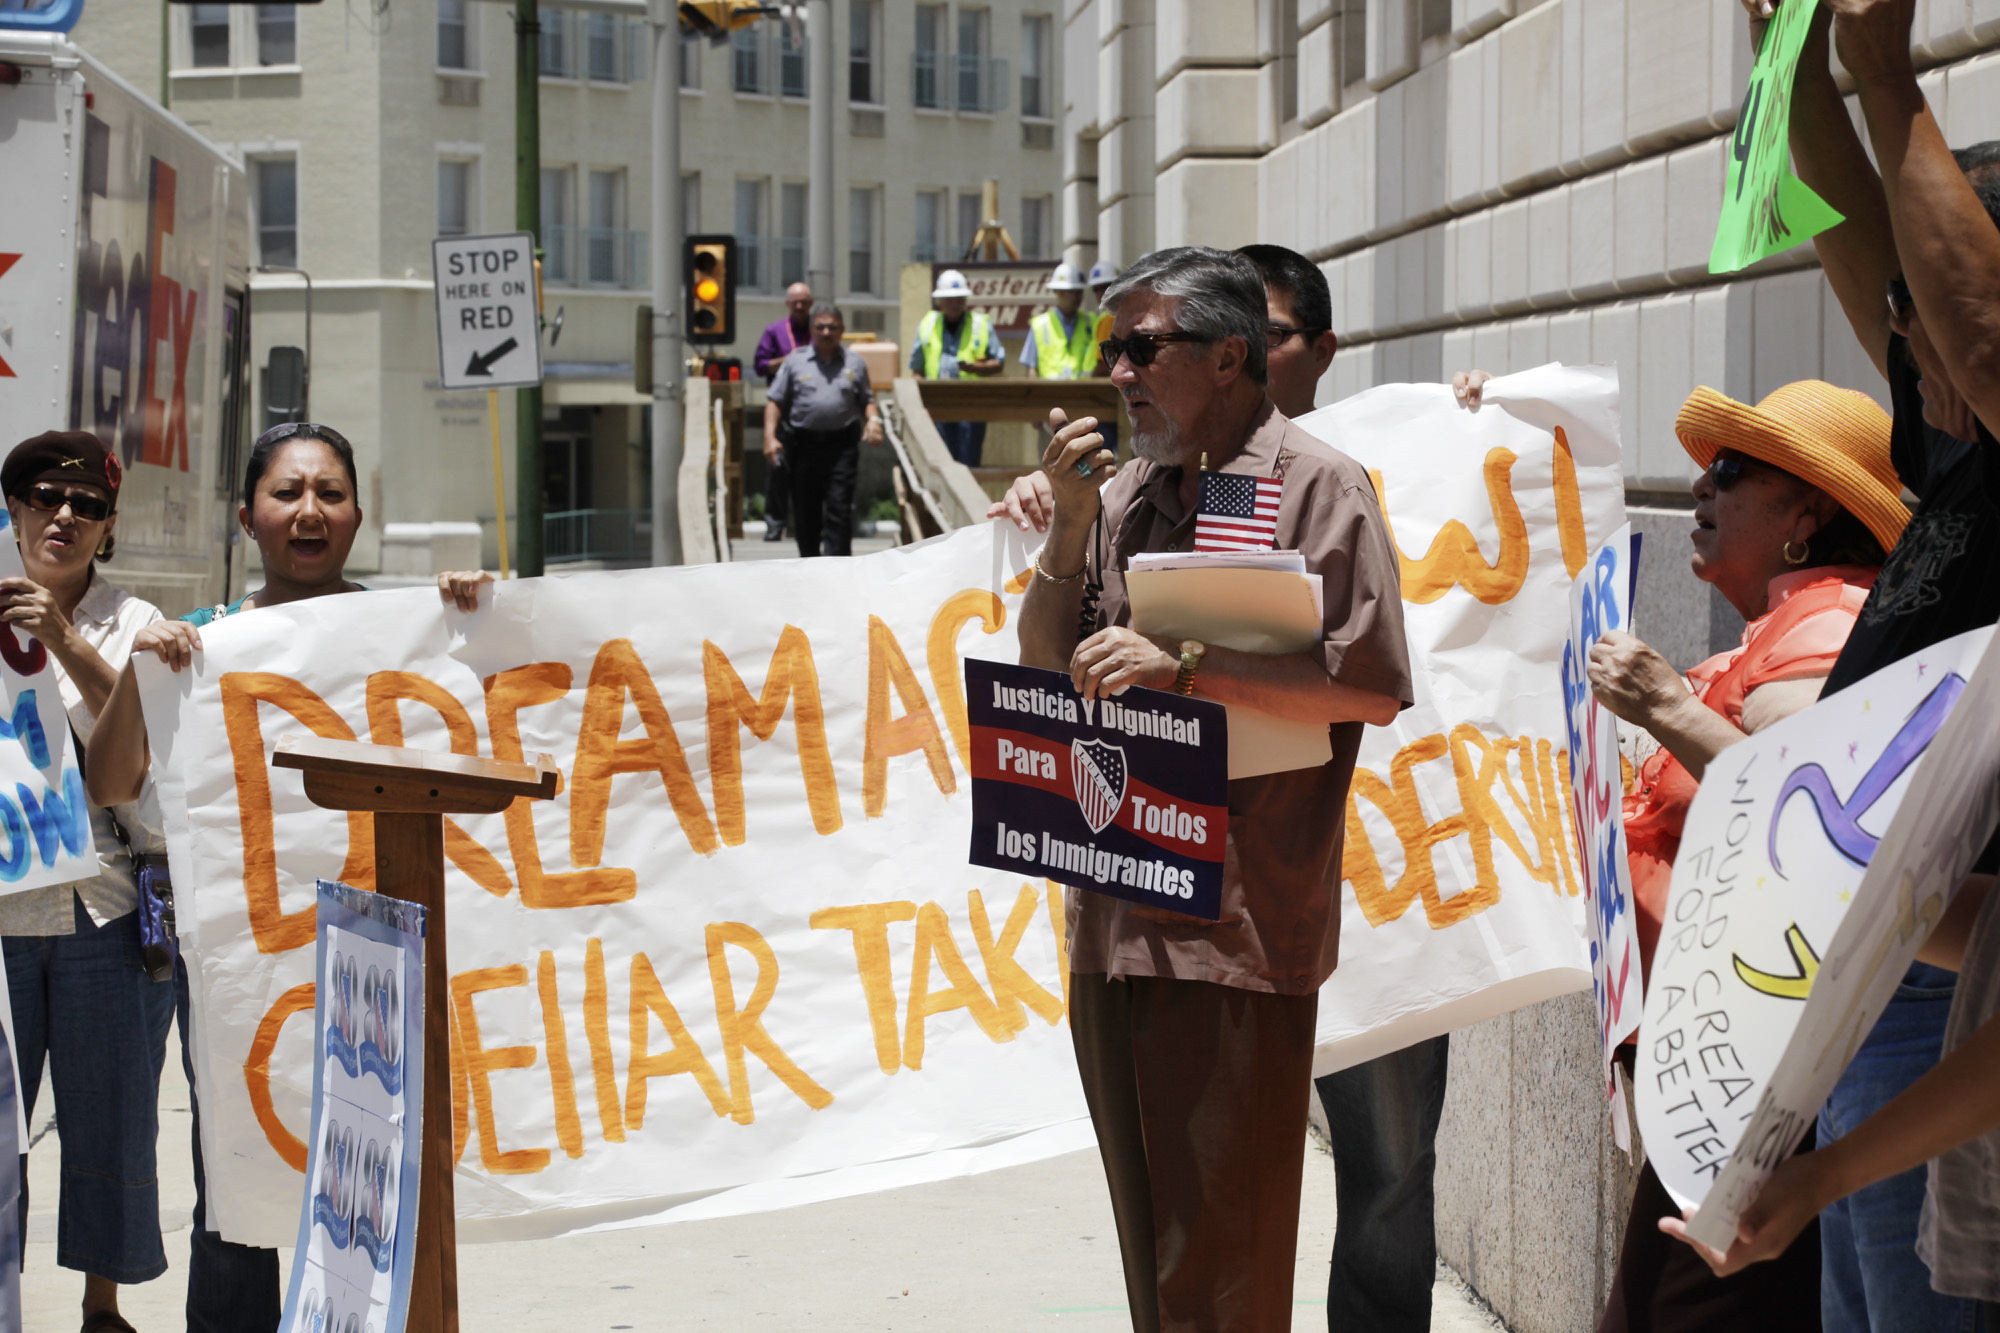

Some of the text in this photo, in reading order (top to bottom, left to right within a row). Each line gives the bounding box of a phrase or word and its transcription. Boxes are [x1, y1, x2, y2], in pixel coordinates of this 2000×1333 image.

[69, 111, 198, 473] FedEx
[445, 281, 526, 299] HERE ON
[449, 249, 519, 275] STOP
[461, 306, 514, 330] RED
[993, 681, 1200, 747] Justicia Y Dignidad
[220, 566, 1036, 953] DREAM AC
[998, 738, 1057, 780] Para
[1077, 750, 1117, 805] LULAC
[1131, 796, 1208, 845] Todos
[1706, 752, 1758, 949] WOULD
[996, 822, 1195, 900] los Inmigrantes
[1663, 846, 1714, 970] FOR
[1656, 985, 1687, 1026] A
[1693, 969, 1756, 1122] CREA
